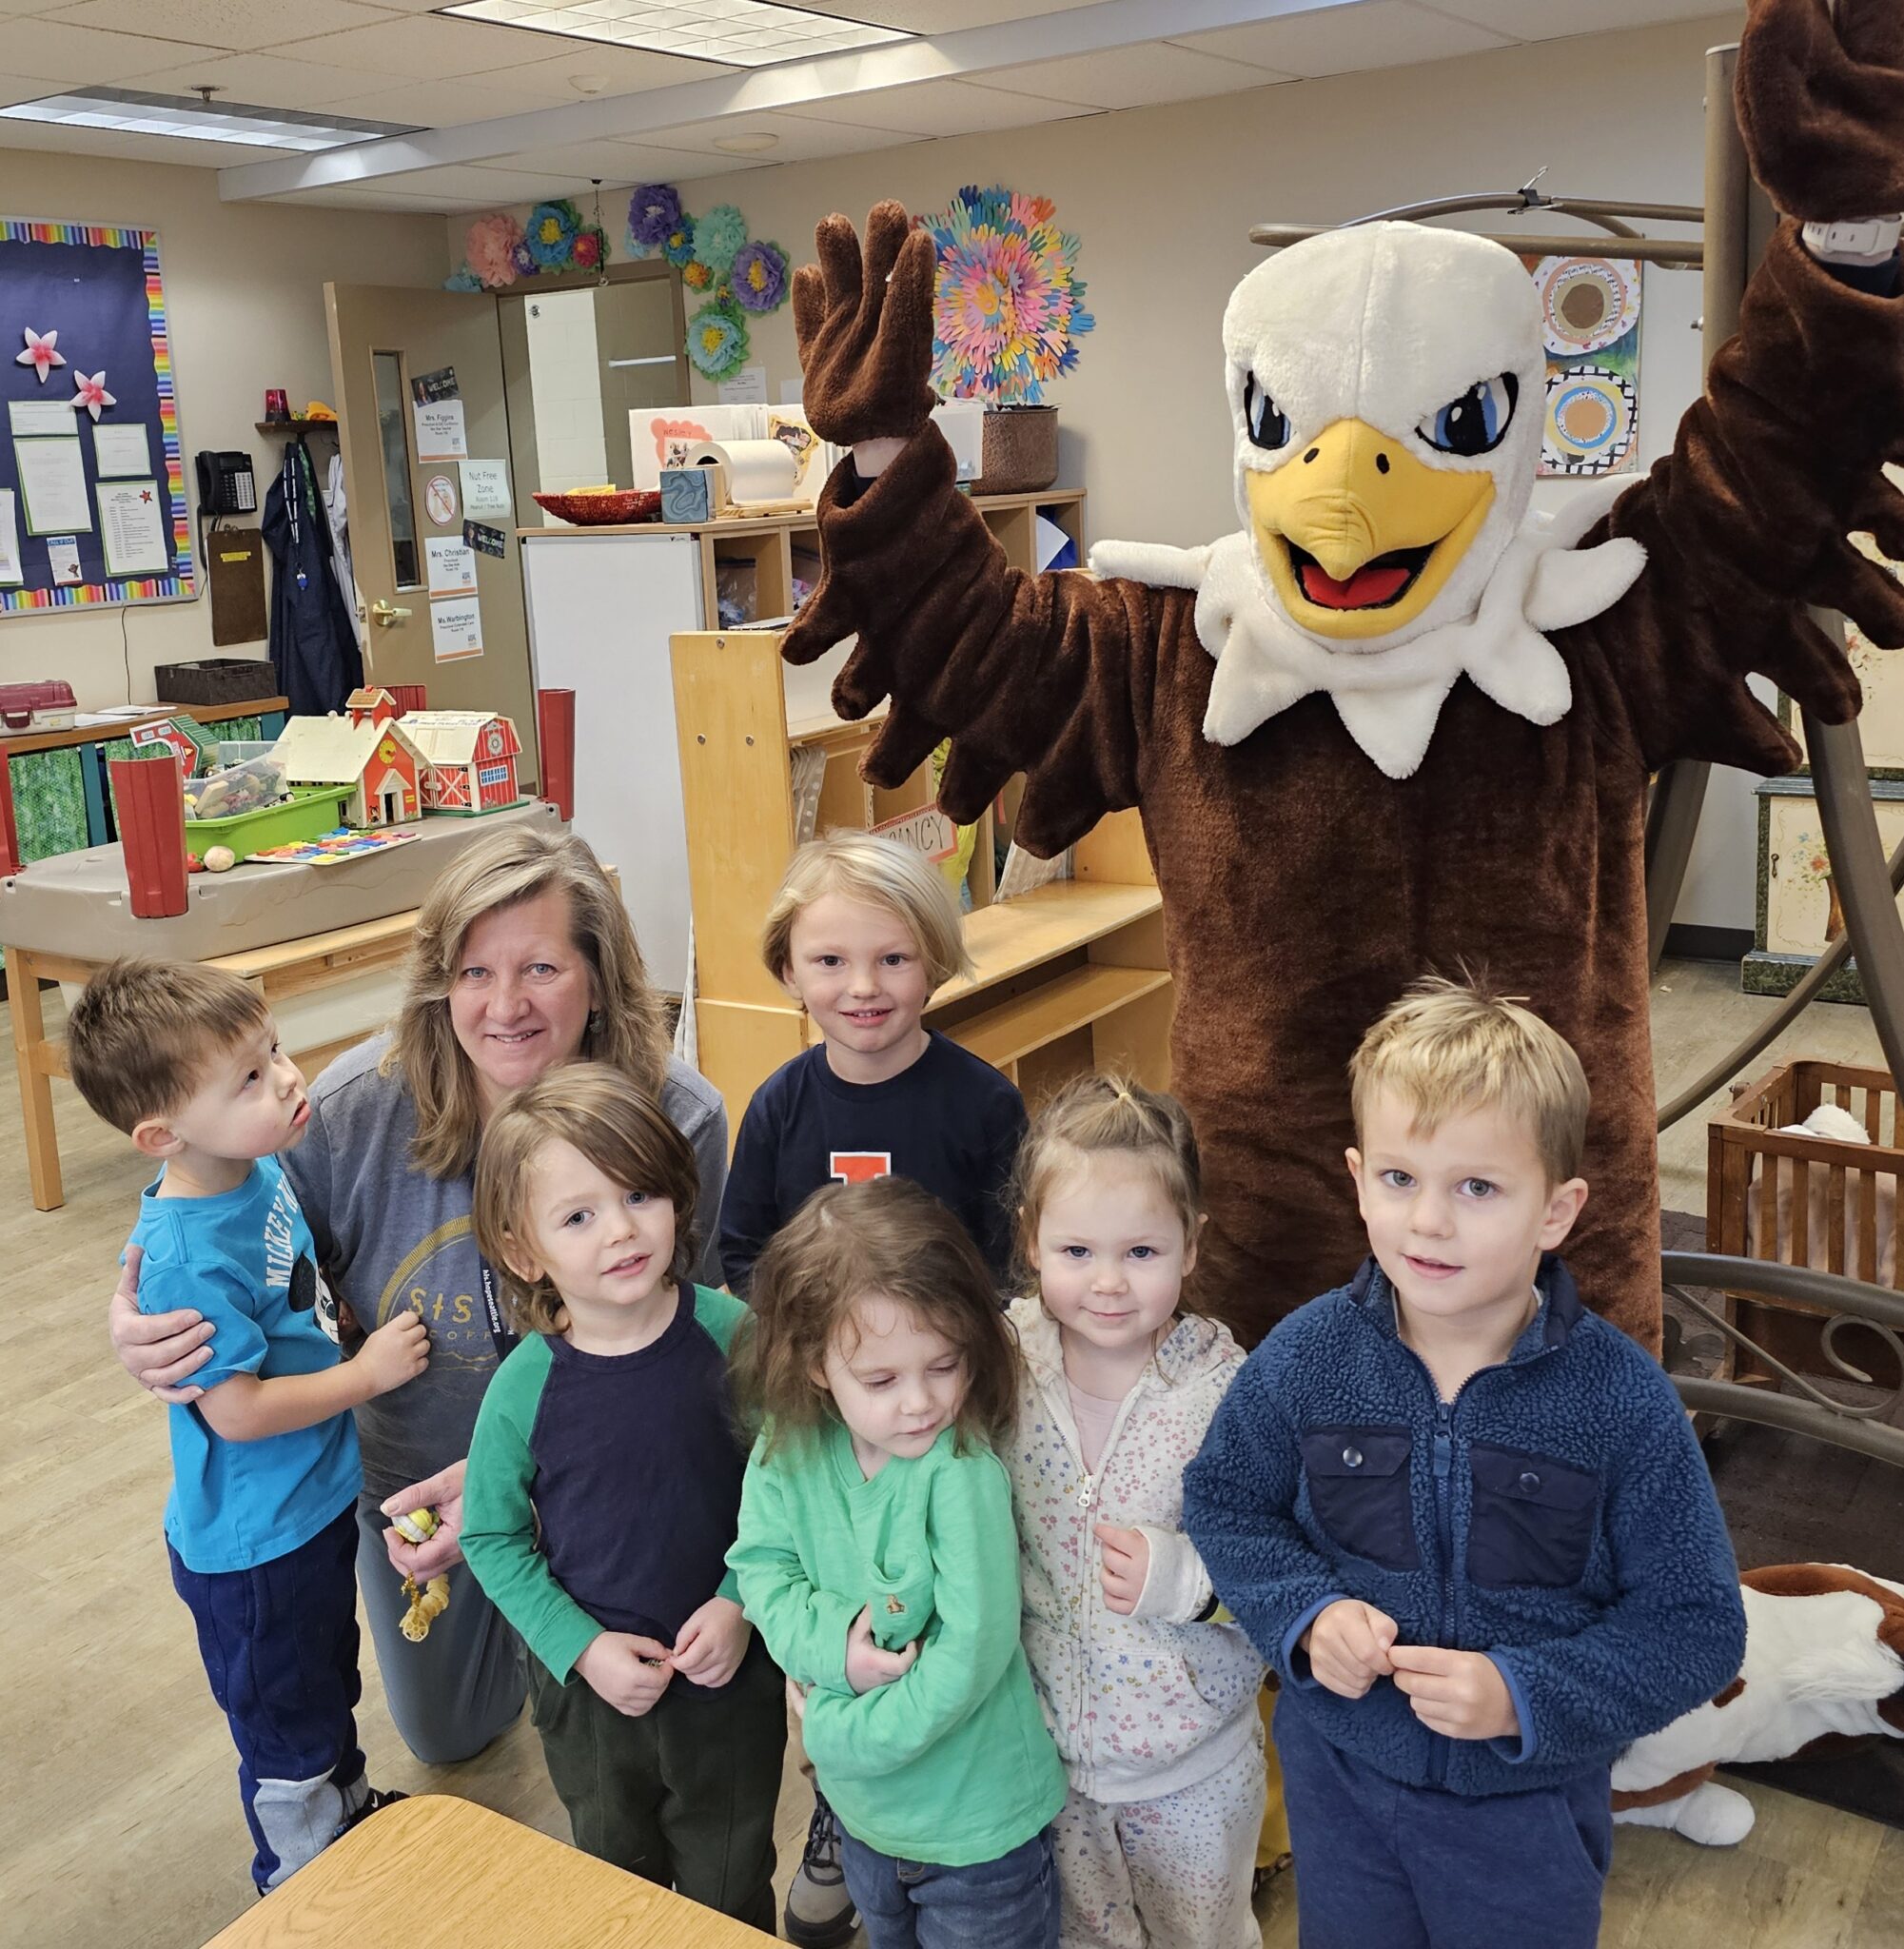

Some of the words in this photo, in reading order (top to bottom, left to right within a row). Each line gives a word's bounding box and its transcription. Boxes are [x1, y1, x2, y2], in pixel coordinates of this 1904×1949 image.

[469, 471, 481, 481] Nut
[482, 471, 498, 480] Free
[477, 484, 494, 493] Zone
[444, 548, 470, 557] Christian
[264, 1193, 294, 1288] MICKEY
